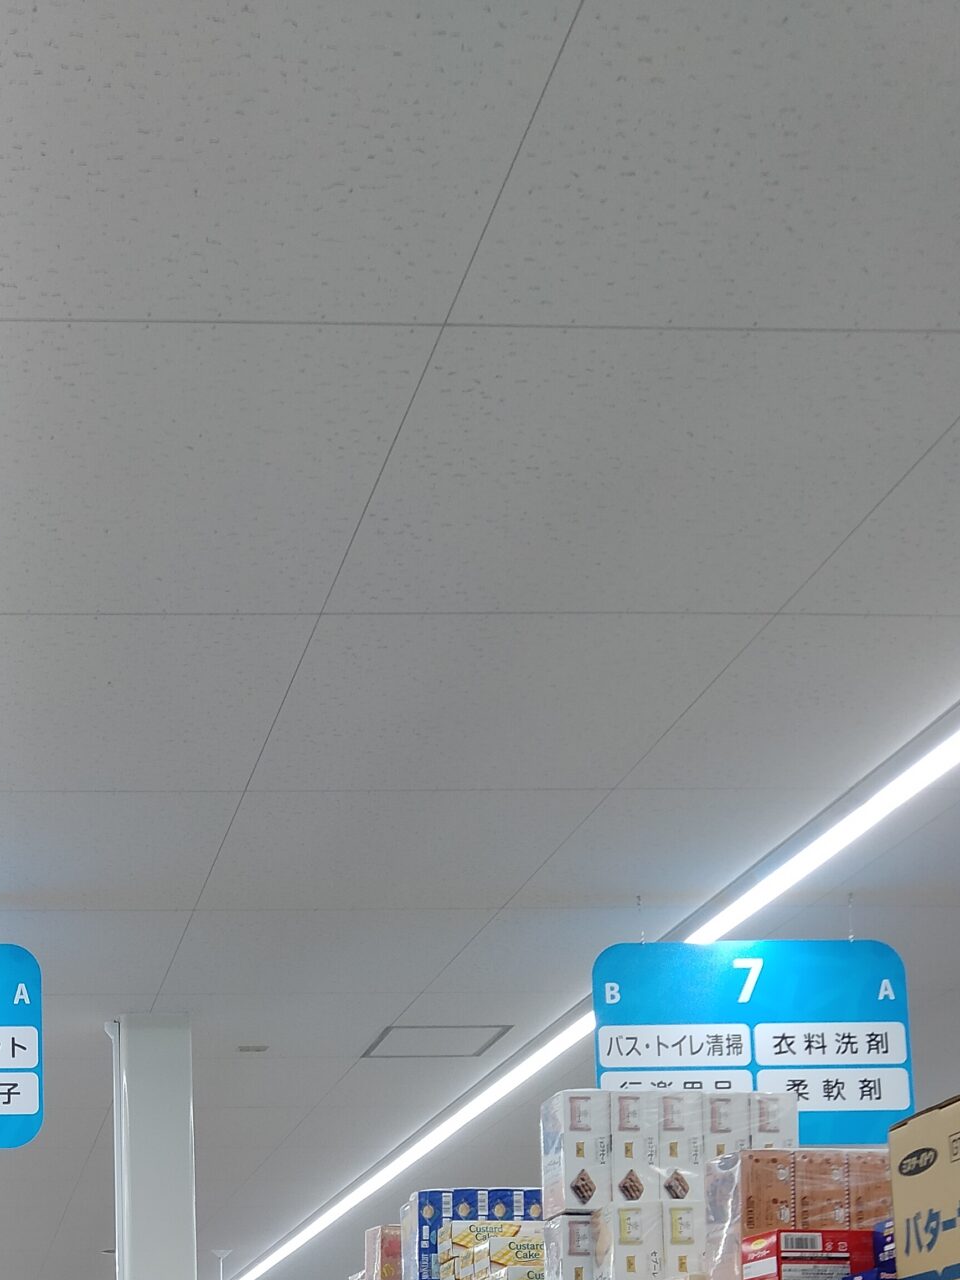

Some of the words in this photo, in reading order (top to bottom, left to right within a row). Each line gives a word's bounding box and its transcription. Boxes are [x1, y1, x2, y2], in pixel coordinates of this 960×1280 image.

[733, 959, 763, 1003] 7
[878, 979, 895, 1000] A
[14, 983, 30, 1004] A
[605, 983, 620, 1003] B
[607, 1034, 743, 1057] バス・トイレ清掃
[773, 1032, 889, 1056] 衣料洗剤
[786, 1078, 882, 1101] 柔軟剤
[469, 1224, 503, 1235] Custard
[904, 1201, 960, 1257] バター
[515, 1250, 540, 1260] Cake
